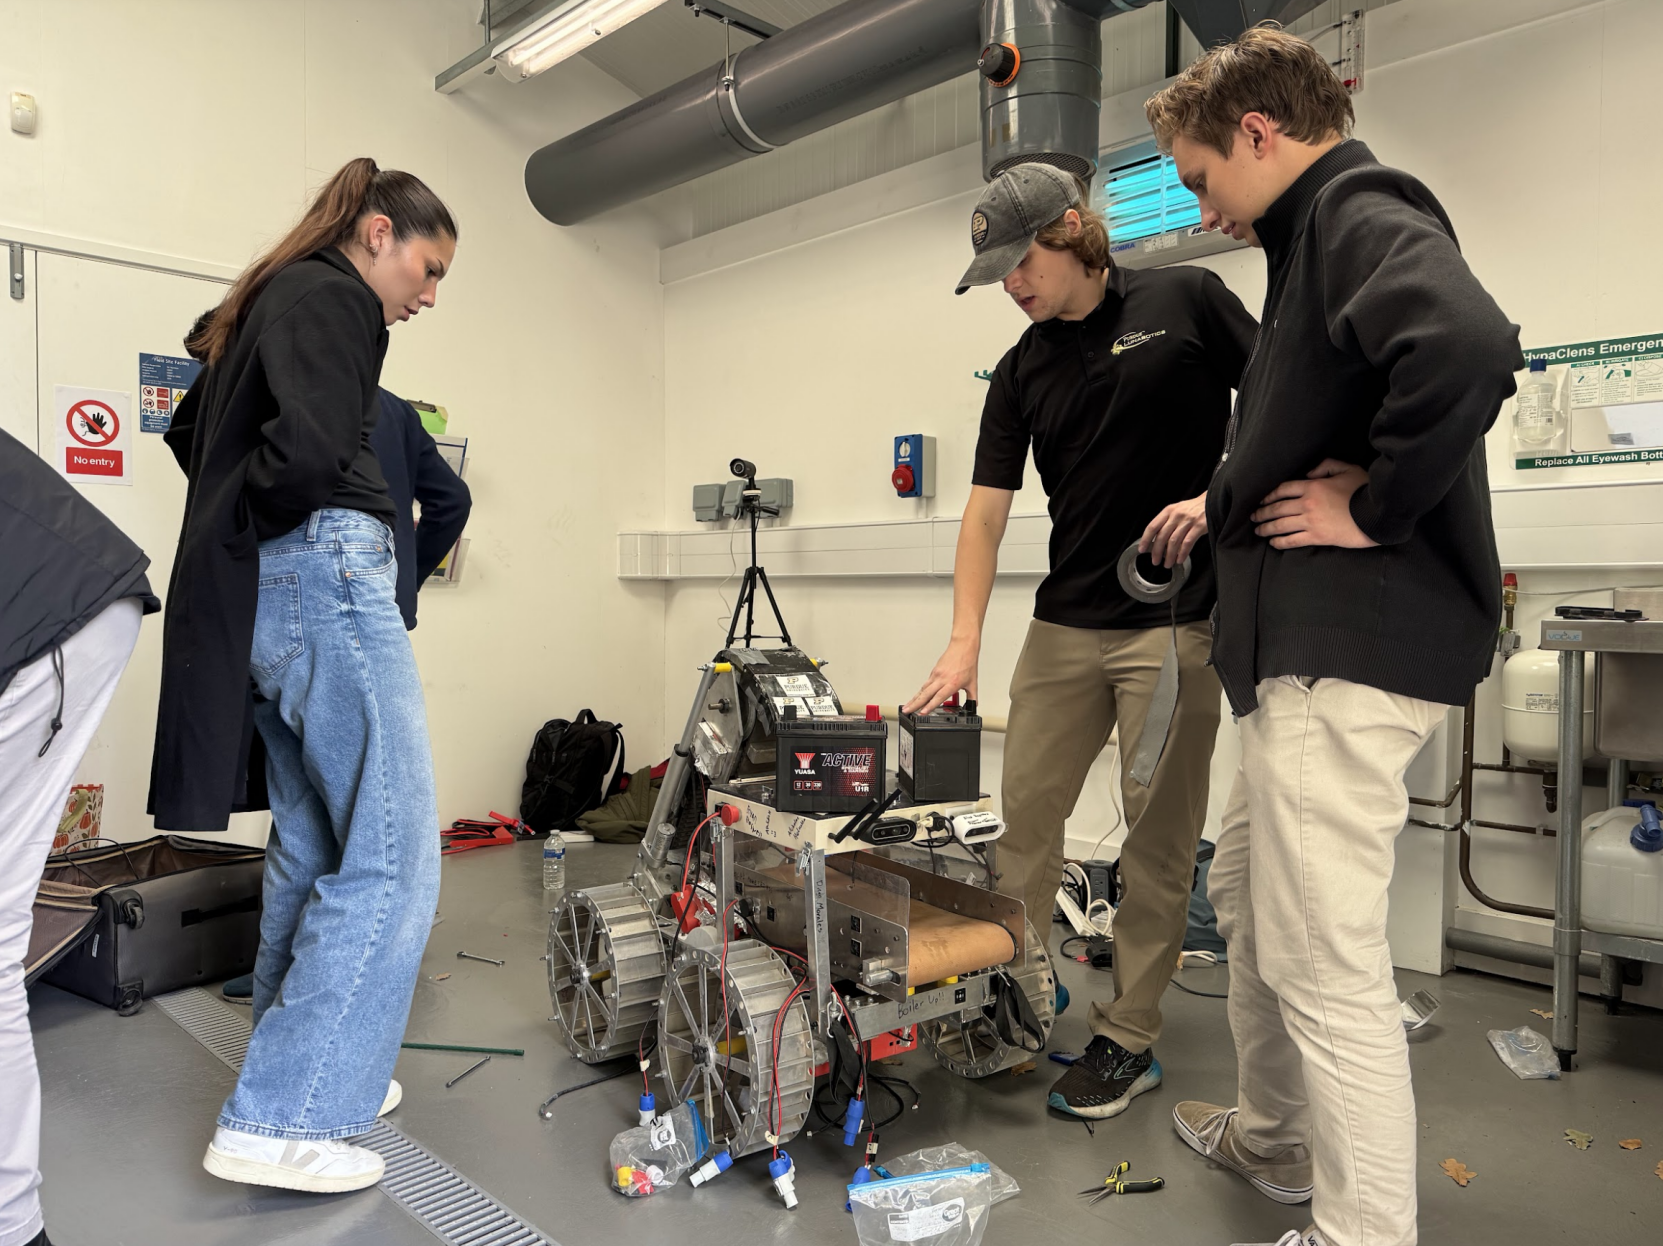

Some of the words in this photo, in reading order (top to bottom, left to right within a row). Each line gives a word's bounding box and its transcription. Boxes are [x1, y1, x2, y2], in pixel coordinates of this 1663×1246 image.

[1110, 242, 1136, 254] COBRA
[1600, 339, 1663, 354] Emergen
[74, 456, 88, 464] No
[89, 458, 115, 468] entry
[1535, 458, 1573, 467] Replace
[1576, 455, 1589, 464] All
[1592, 452, 1637, 464] Eyewash
[822, 753, 873, 766] ACTIVE
[898, 1000, 924, 1019] Boiler
